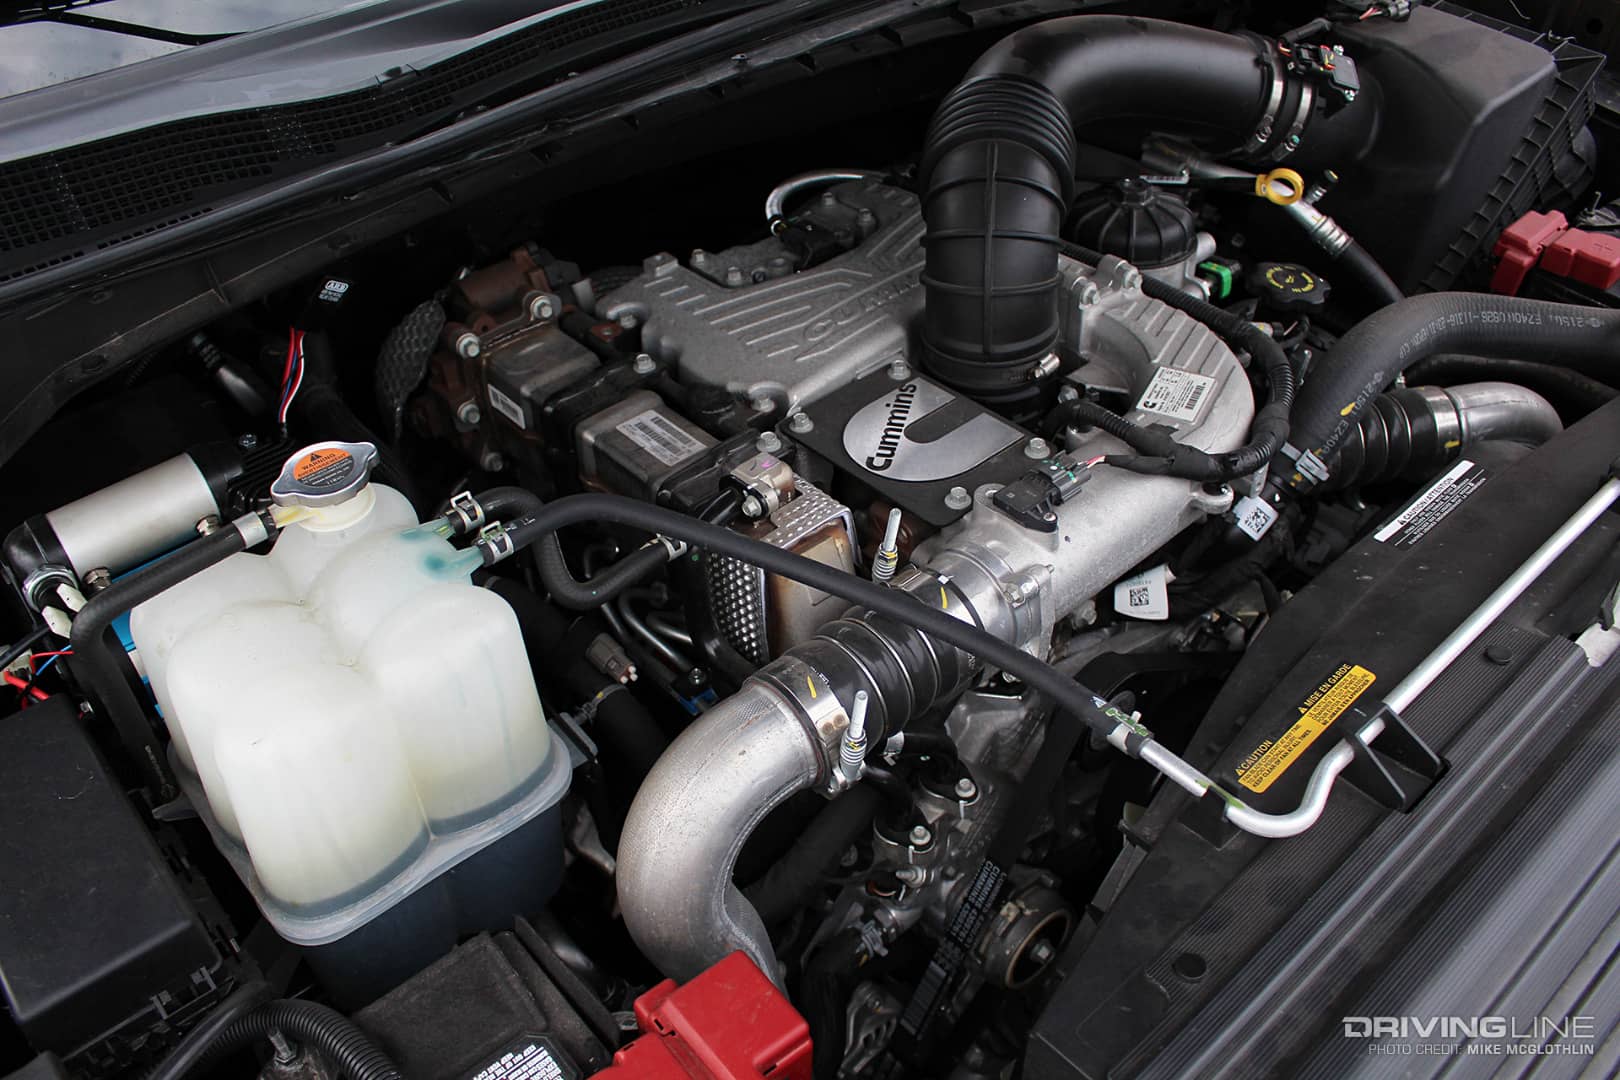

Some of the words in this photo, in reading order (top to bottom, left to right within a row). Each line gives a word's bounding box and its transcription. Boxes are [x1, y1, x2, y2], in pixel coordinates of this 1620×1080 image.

[866, 383, 916, 471] Cummins
[1303, 691, 1323, 707] MISE
[1319, 682, 1331, 693] EN
[1327, 663, 1352, 685] GARDE
[1240, 739, 1273, 770] CAUTION
[967, 860, 994, 903] CUMMINS
[974, 865, 1001, 908] CUMMINS
